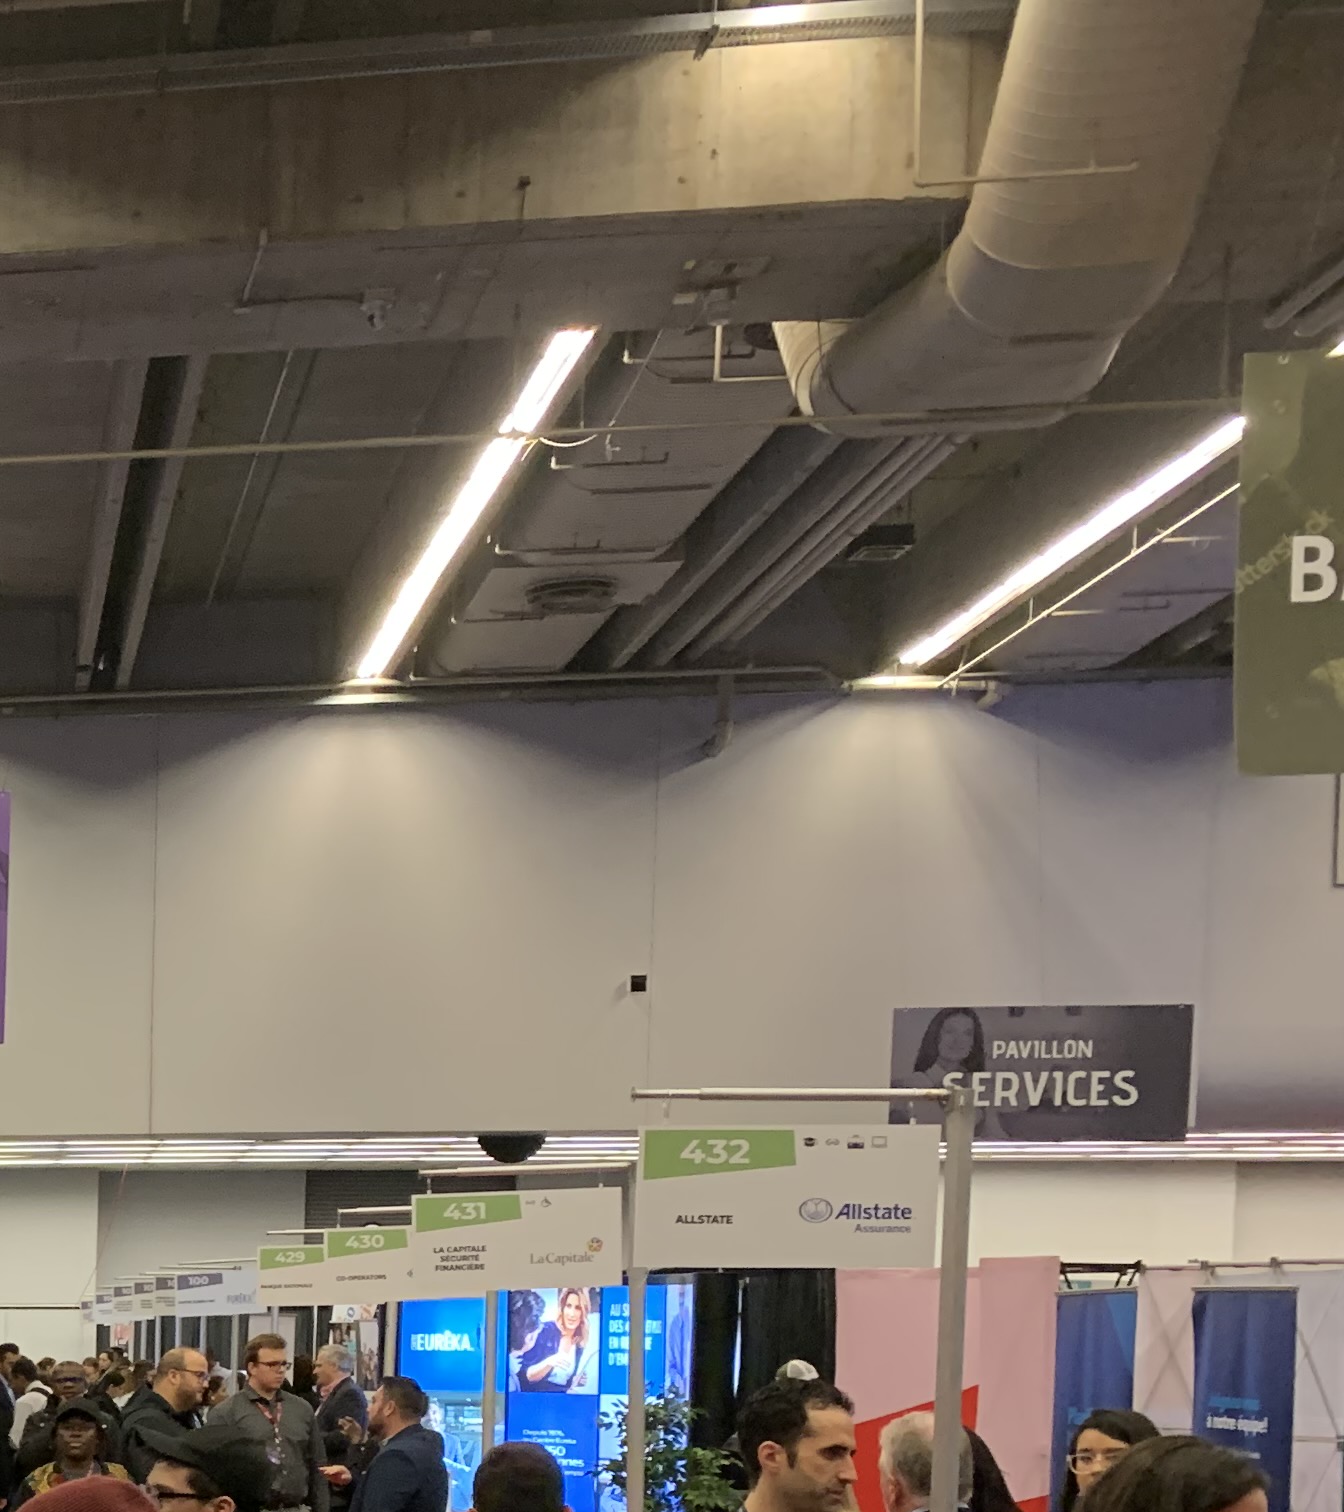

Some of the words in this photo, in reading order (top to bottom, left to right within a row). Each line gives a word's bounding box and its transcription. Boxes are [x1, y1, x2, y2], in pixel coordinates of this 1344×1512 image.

[1291, 535, 1344, 603] B
[992, 1039, 1093, 1060] PAVILLON
[680, 1139, 750, 1165] 432
[443, 1202, 486, 1221] 431
[835, 1203, 912, 1220] Allstate
[675, 1214, 734, 1225] ALLSTATE
[854, 1223, 912, 1234] Assurance
[345, 1235, 385, 1249] 430
[447, 1245, 487, 1253] CAPITALE
[275, 1251, 306, 1263] 429
